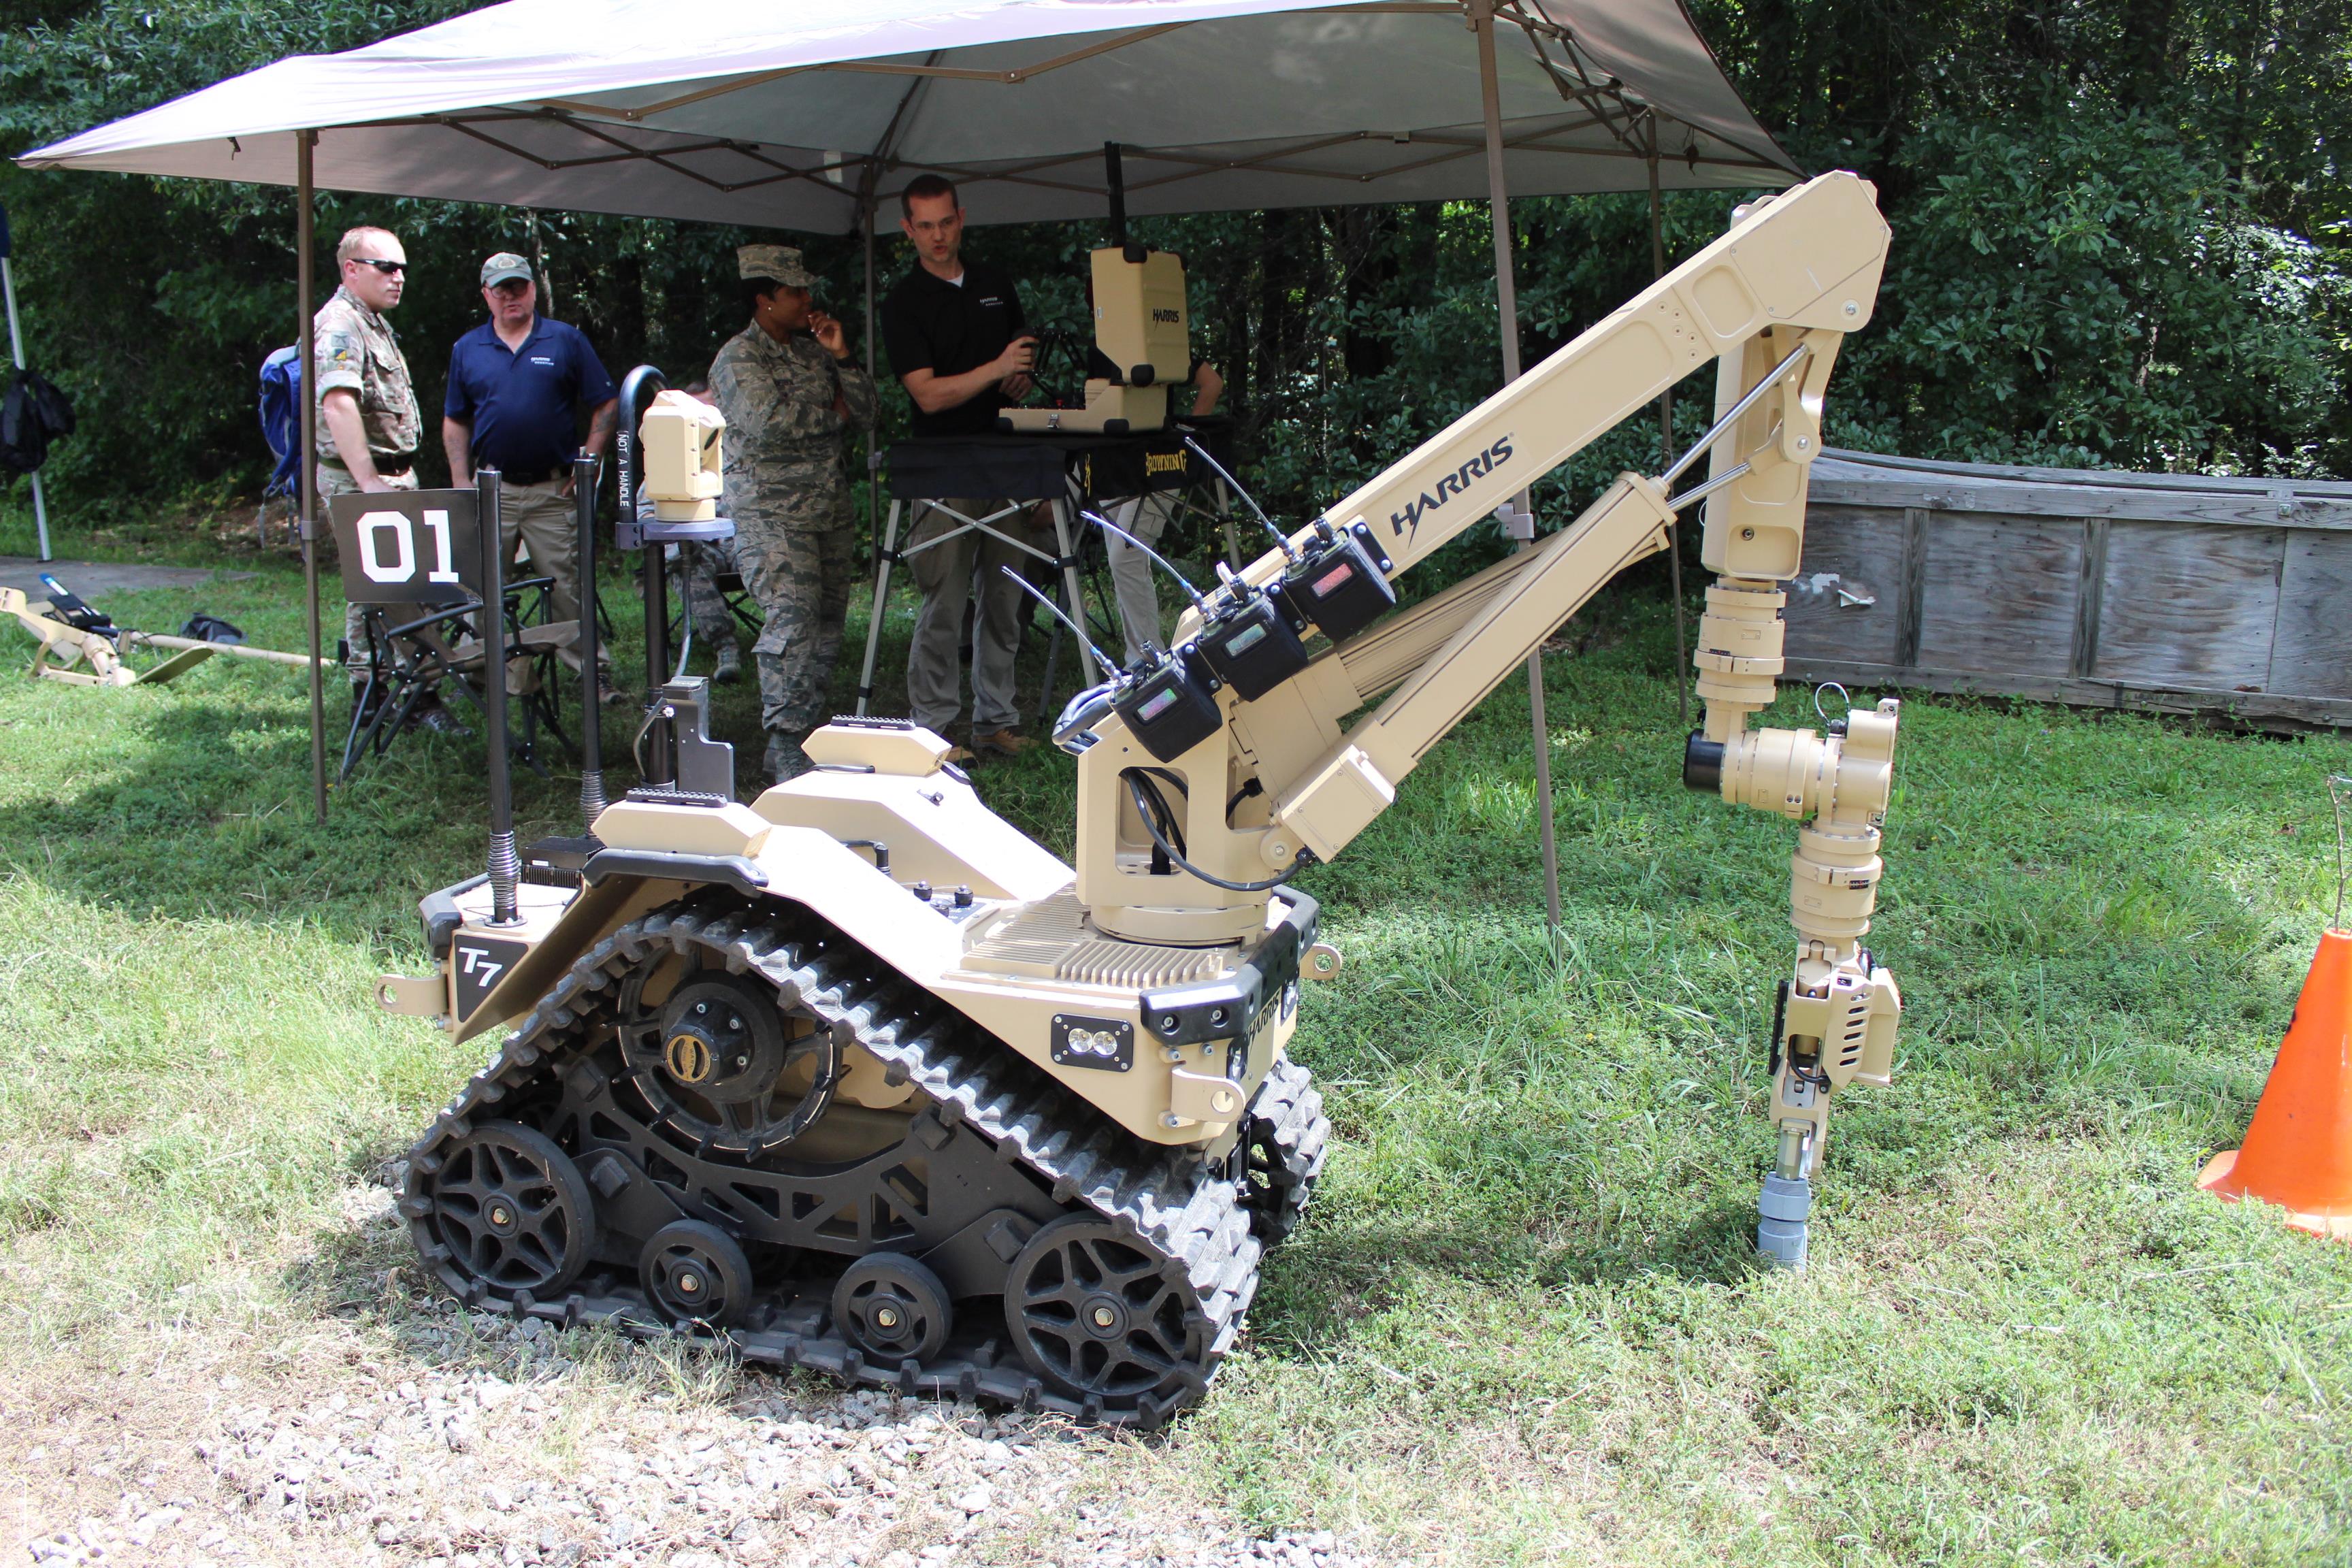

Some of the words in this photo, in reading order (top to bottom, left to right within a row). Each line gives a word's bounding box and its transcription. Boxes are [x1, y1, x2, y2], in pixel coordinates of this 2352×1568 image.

[1153, 308, 1179, 331] HARRIS
[617, 434, 630, 453] NOT
[1146, 449, 1187, 476] BROWNING
[619, 471, 630, 507] HANDLE
[1390, 434, 1513, 550] HARRIS
[357, 510, 459, 583] 01
[458, 947, 502, 987] T7
[1248, 992, 1279, 1052] HARRIS
